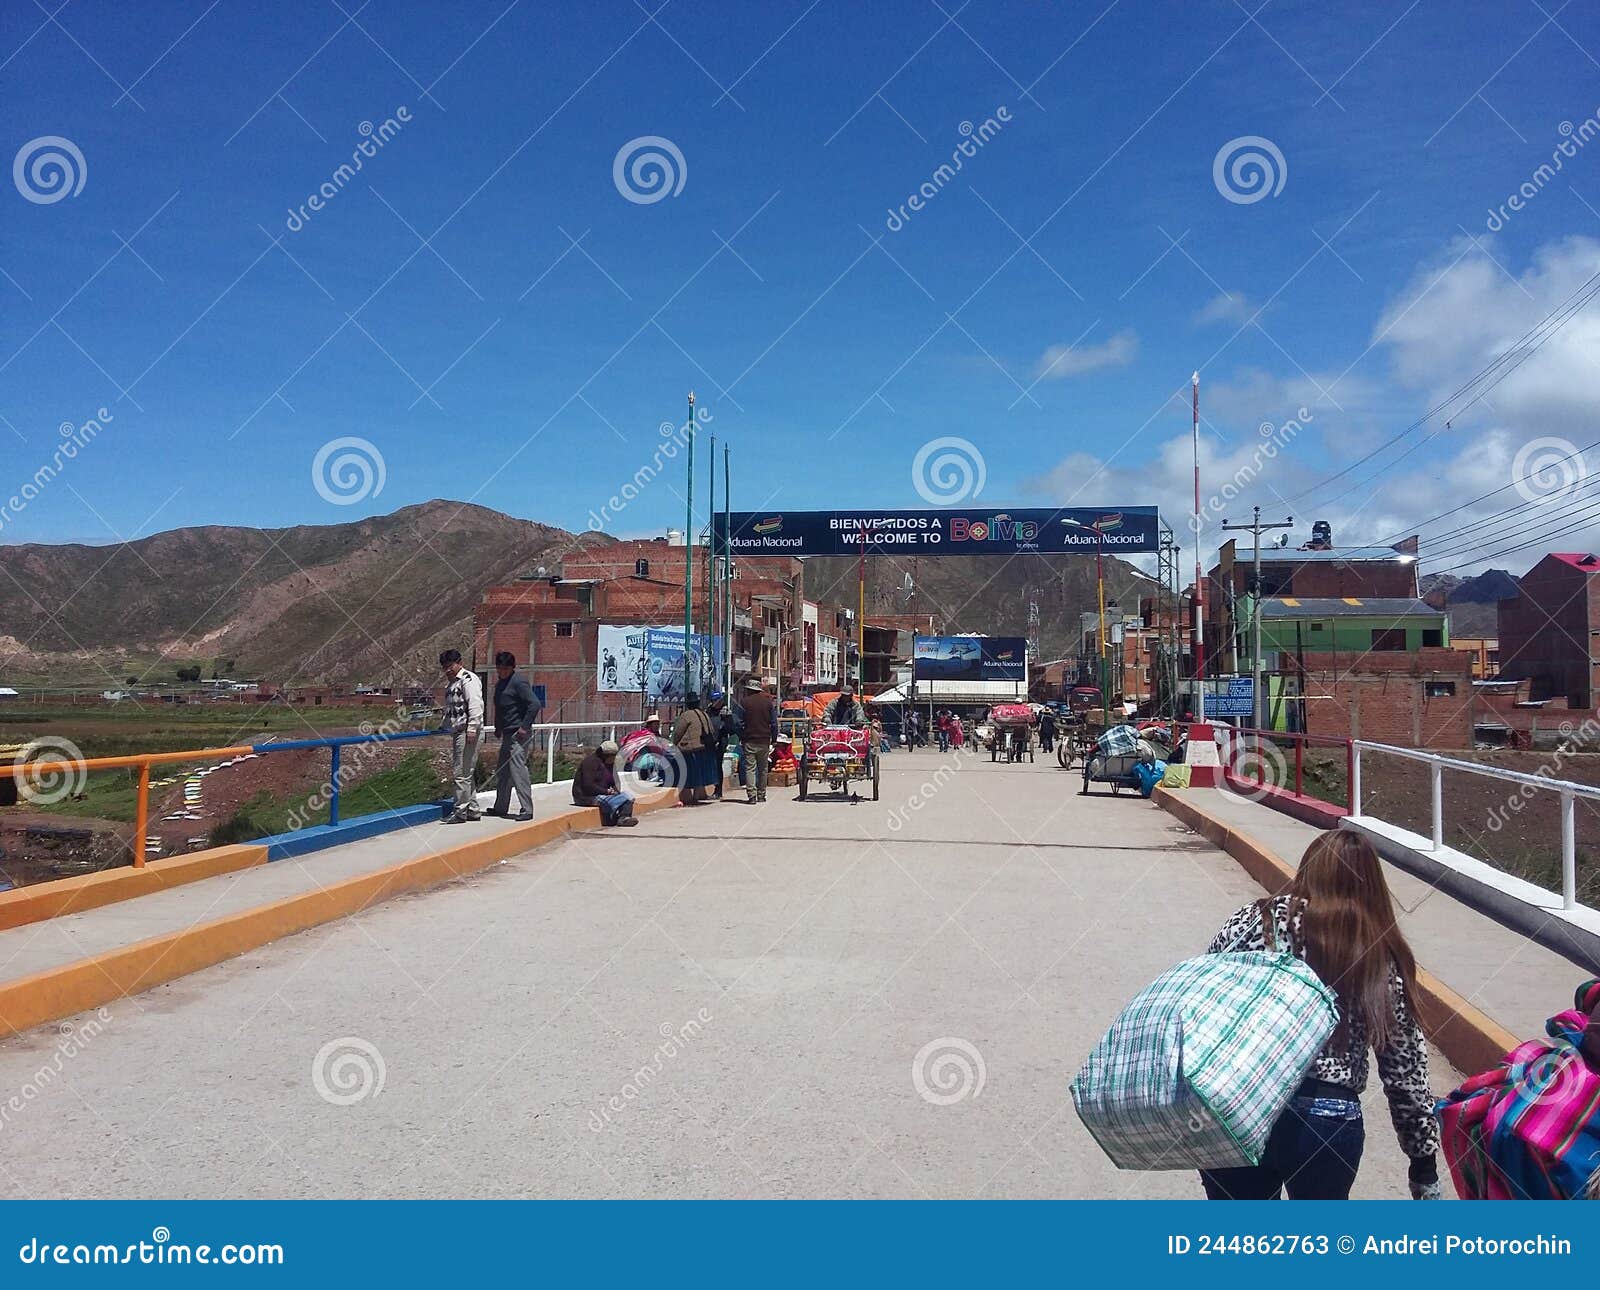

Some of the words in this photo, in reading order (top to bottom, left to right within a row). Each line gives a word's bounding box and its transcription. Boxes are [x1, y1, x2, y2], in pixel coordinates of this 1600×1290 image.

[931, 518, 942, 529] A
[949, 516, 1039, 541] Bolivia
[727, 537, 761, 547] Aduana
[762, 536, 803, 547] Nacional
[842, 533, 918, 544] WELCOME
[921, 533, 941, 543] TO
[1063, 534, 1100, 545] Aduana
[1102, 533, 1145, 544] Nacional
